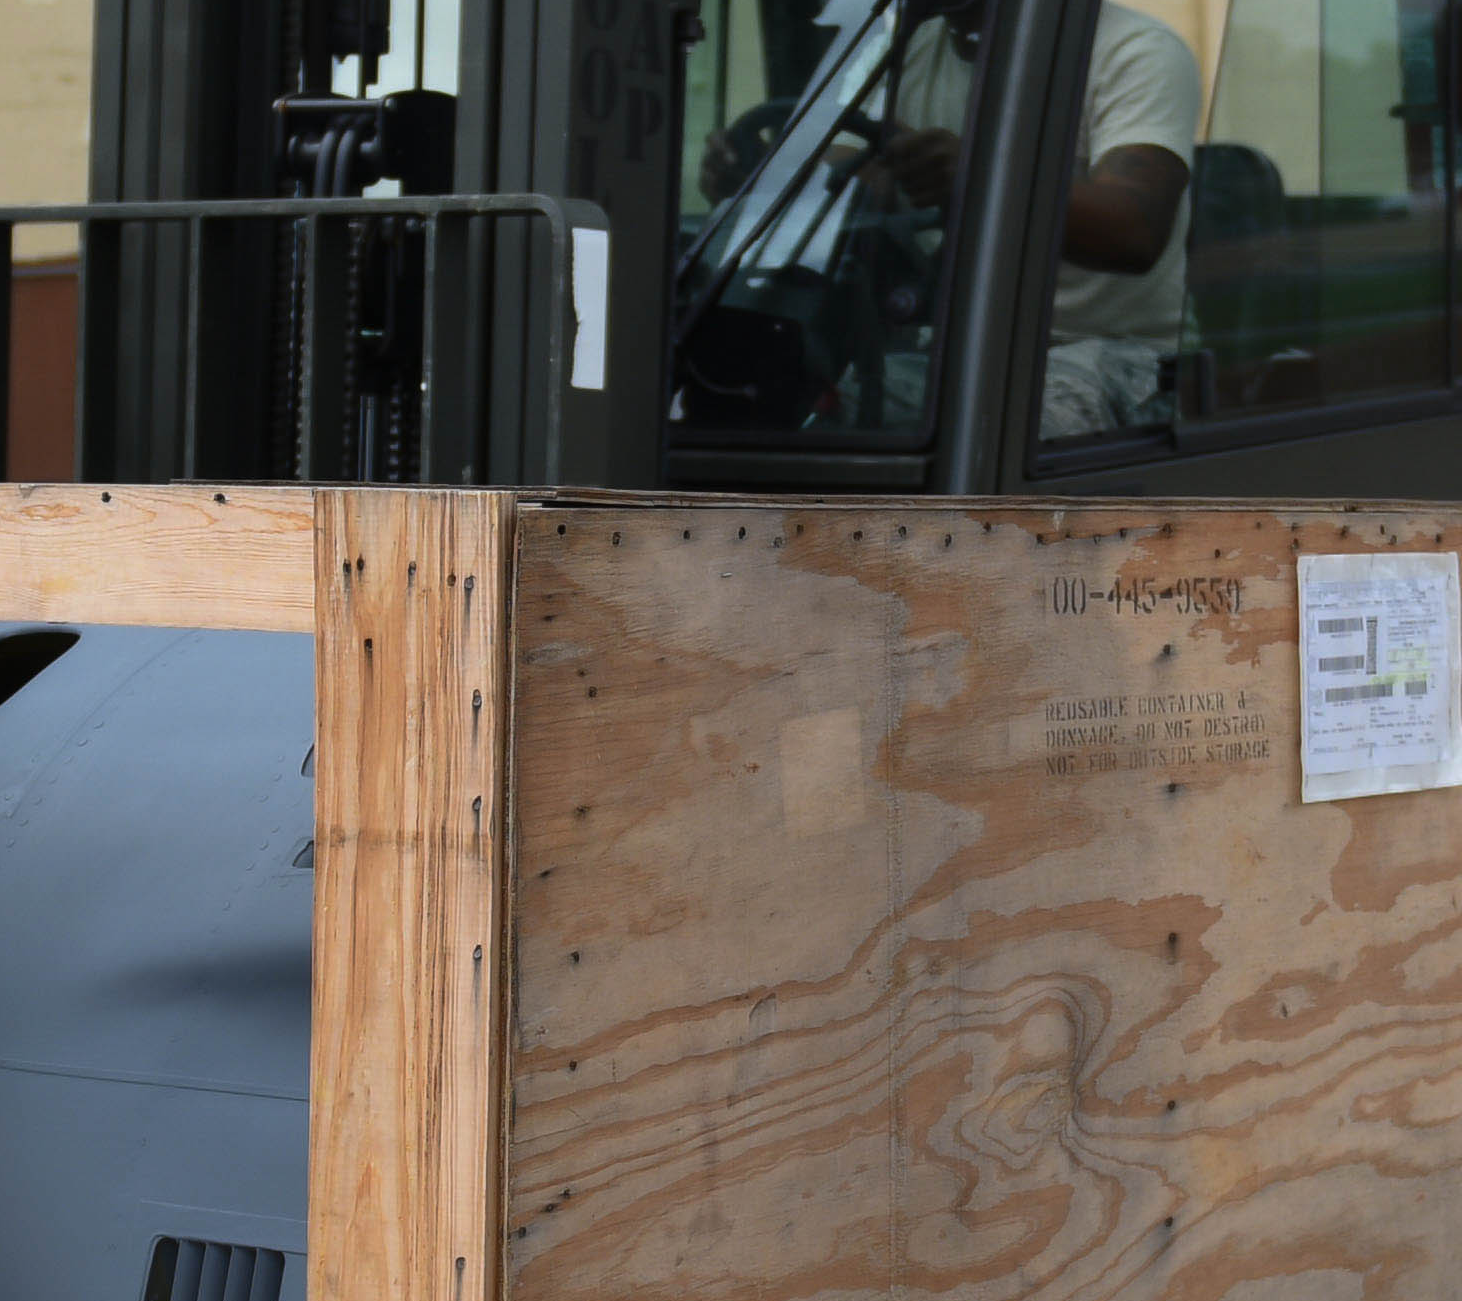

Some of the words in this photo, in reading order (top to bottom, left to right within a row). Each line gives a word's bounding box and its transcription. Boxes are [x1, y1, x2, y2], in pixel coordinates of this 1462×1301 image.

[1045, 696, 1128, 722] REUSABLE
[1137, 691, 1225, 715] CONTAINER
[1136, 721, 1156, 741] DO
[1164, 719, 1193, 741] NOT
[1204, 713, 1267, 738] DESTROY
[1045, 754, 1076, 777] NOT
[1088, 749, 1118, 773] FOR
[1128, 744, 1198, 771] OUTSIDE
[1204, 738, 1271, 765] STORAGE
